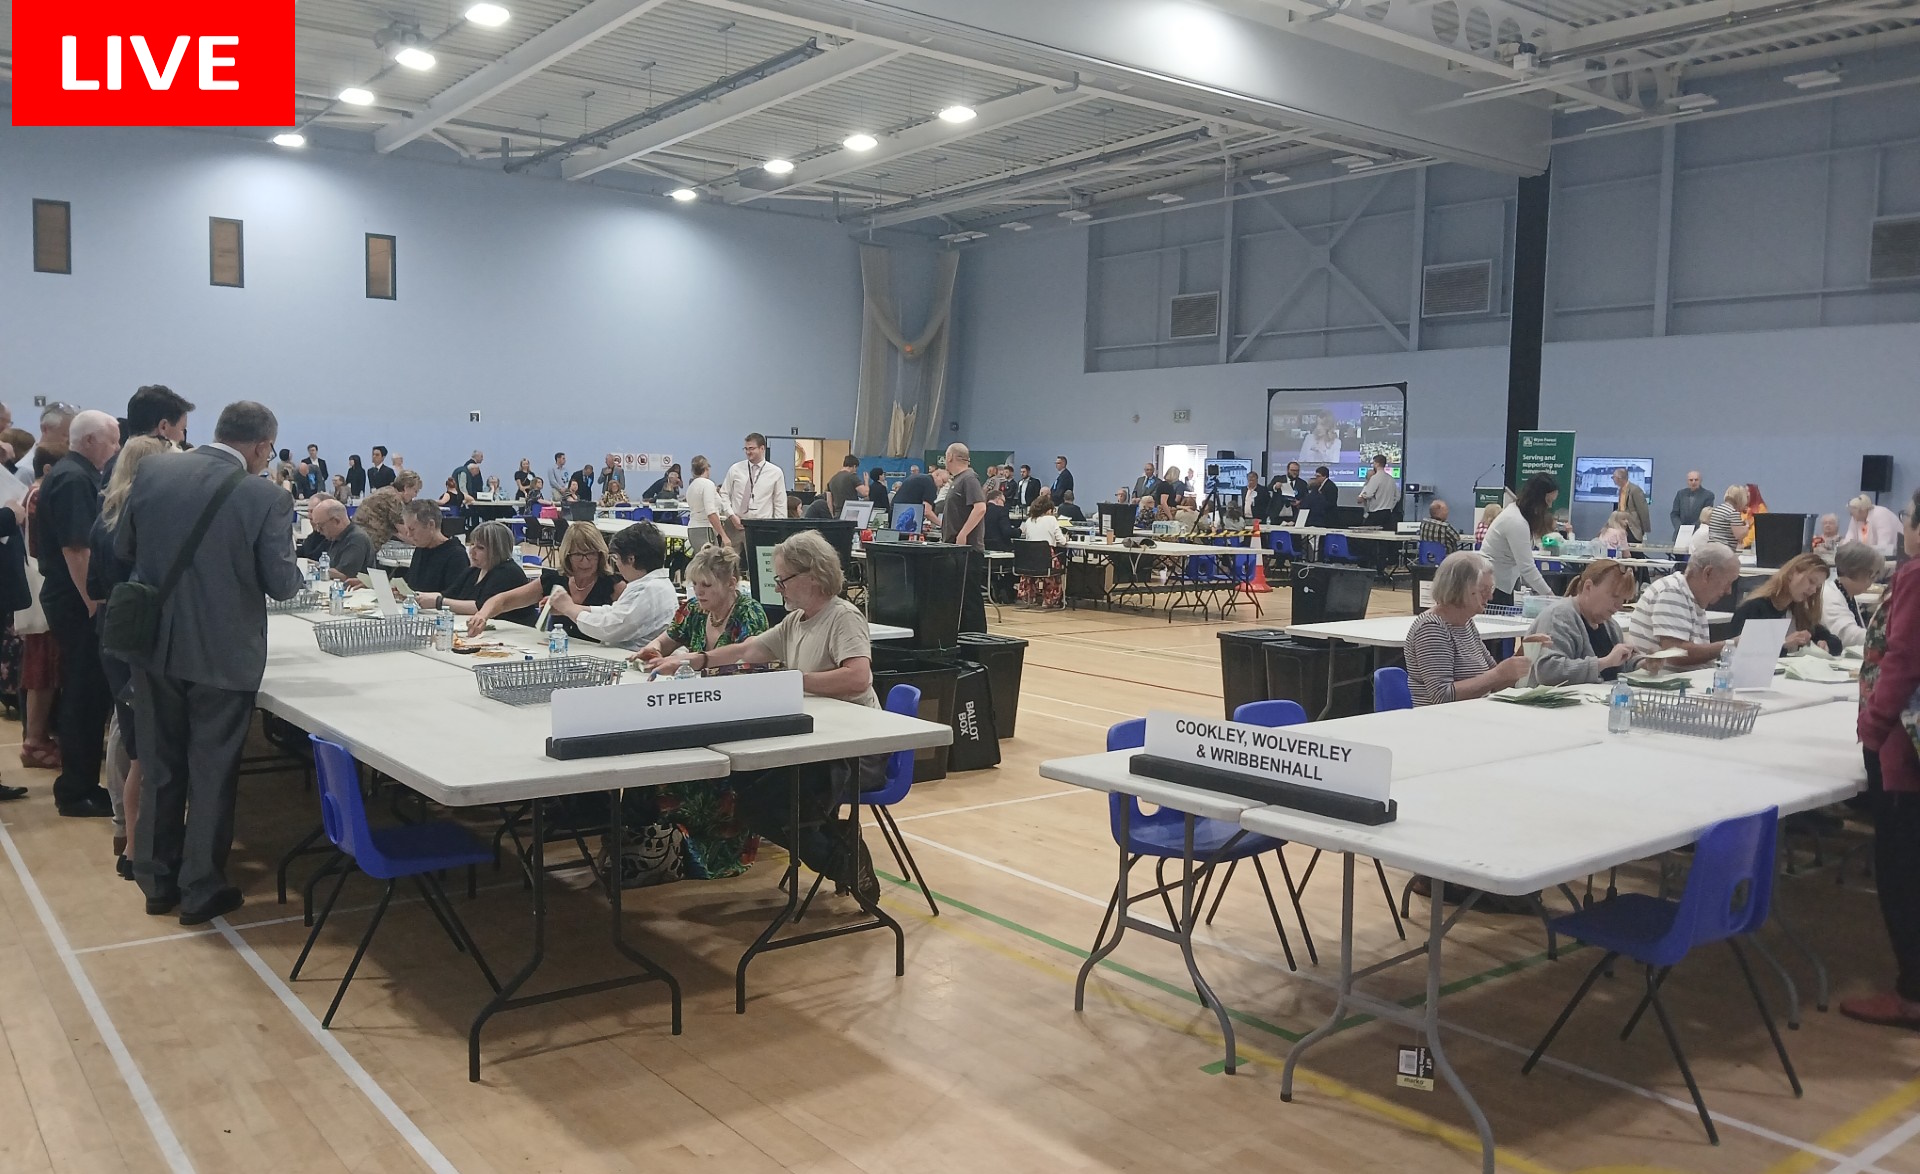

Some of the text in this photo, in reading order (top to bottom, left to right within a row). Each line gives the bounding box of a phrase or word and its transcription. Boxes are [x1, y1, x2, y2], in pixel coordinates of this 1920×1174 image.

[1522, 454, 1543, 462] Serving
[647, 690, 722, 707] ST PETERS
[958, 712, 969, 736] BOX
[965, 700, 979, 741] BALLOT
[1176, 719, 1352, 762] COOKLEY, WOLVERLEY
[1196, 744, 1322, 781] & WRIBBENHALL
